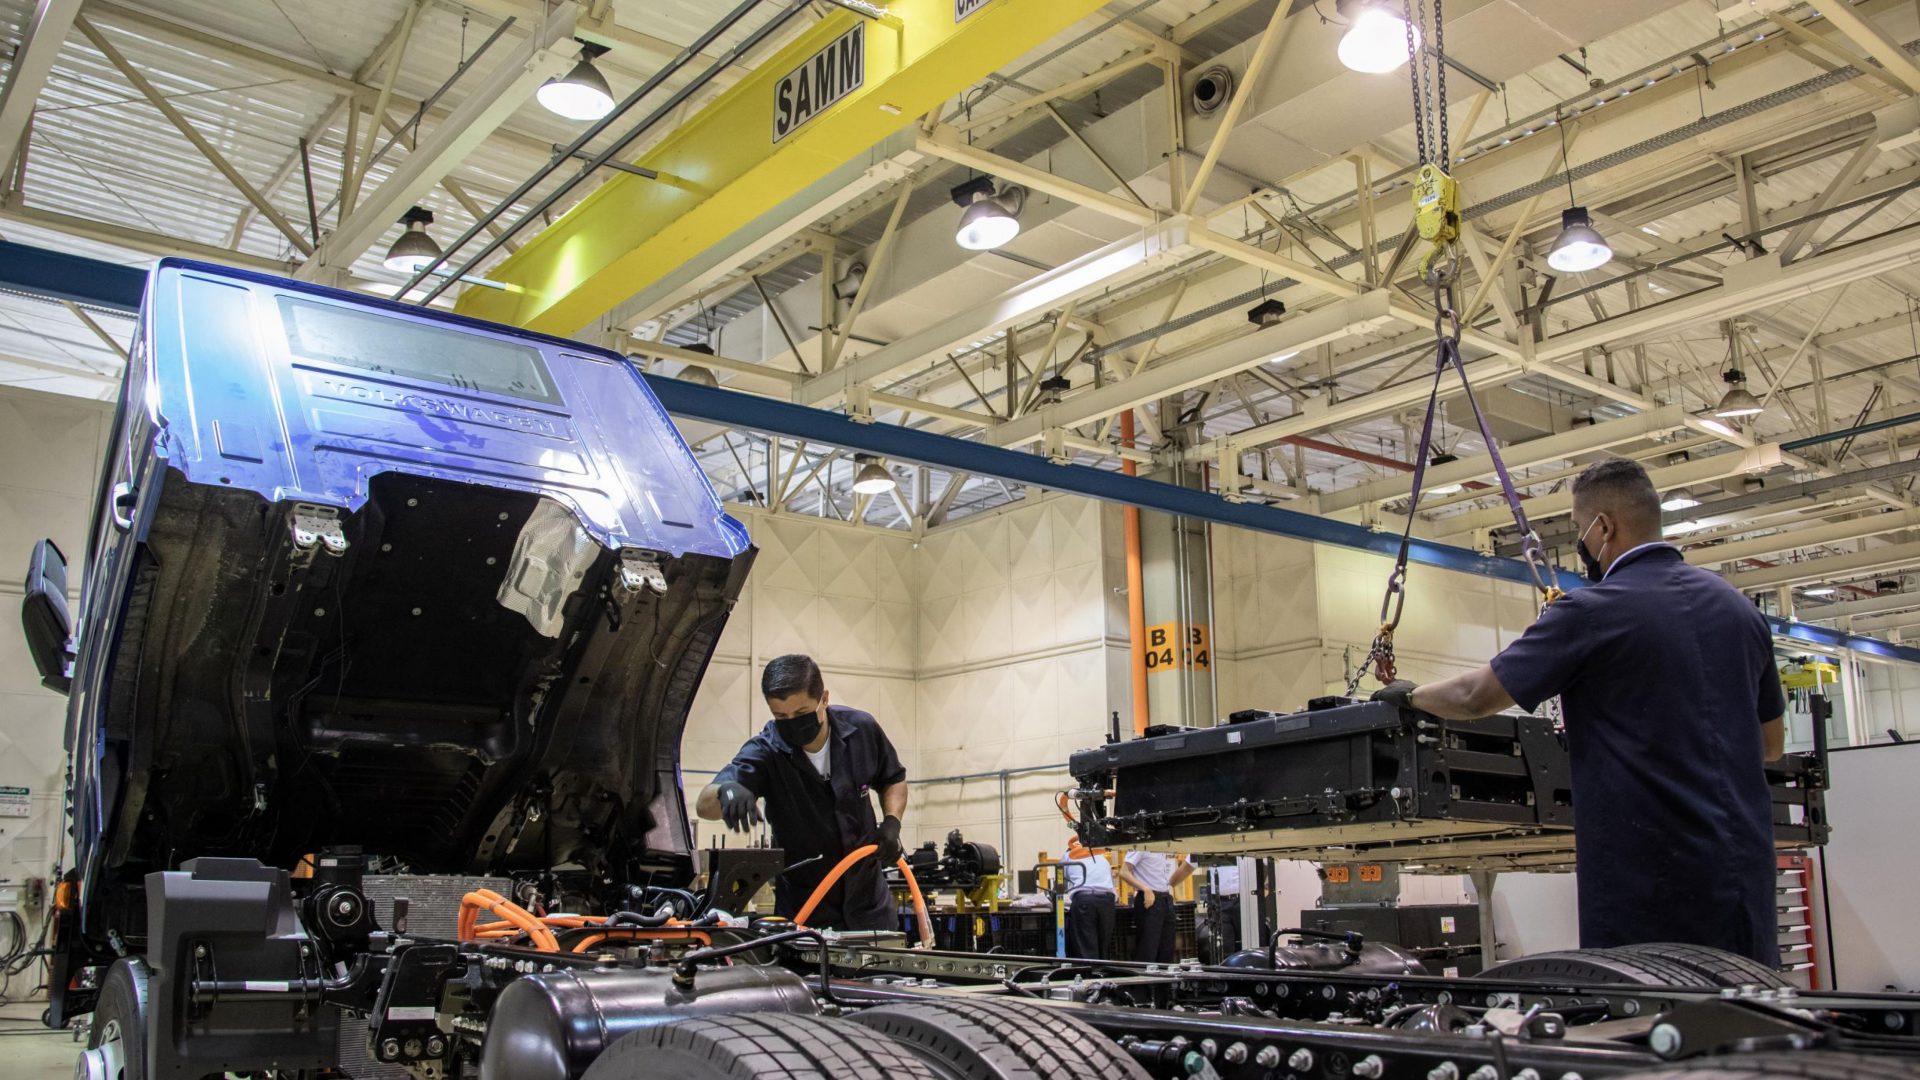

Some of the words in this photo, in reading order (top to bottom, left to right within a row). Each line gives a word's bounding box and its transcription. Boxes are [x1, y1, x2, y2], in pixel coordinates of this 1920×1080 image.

[777, 28, 861, 135] SAMM
[325, 380, 556, 433] VOLKSWAGEN
[1151, 628, 1167, 647] B
[1187, 627, 1202, 645] B
[1145, 648, 1174, 668] 04
